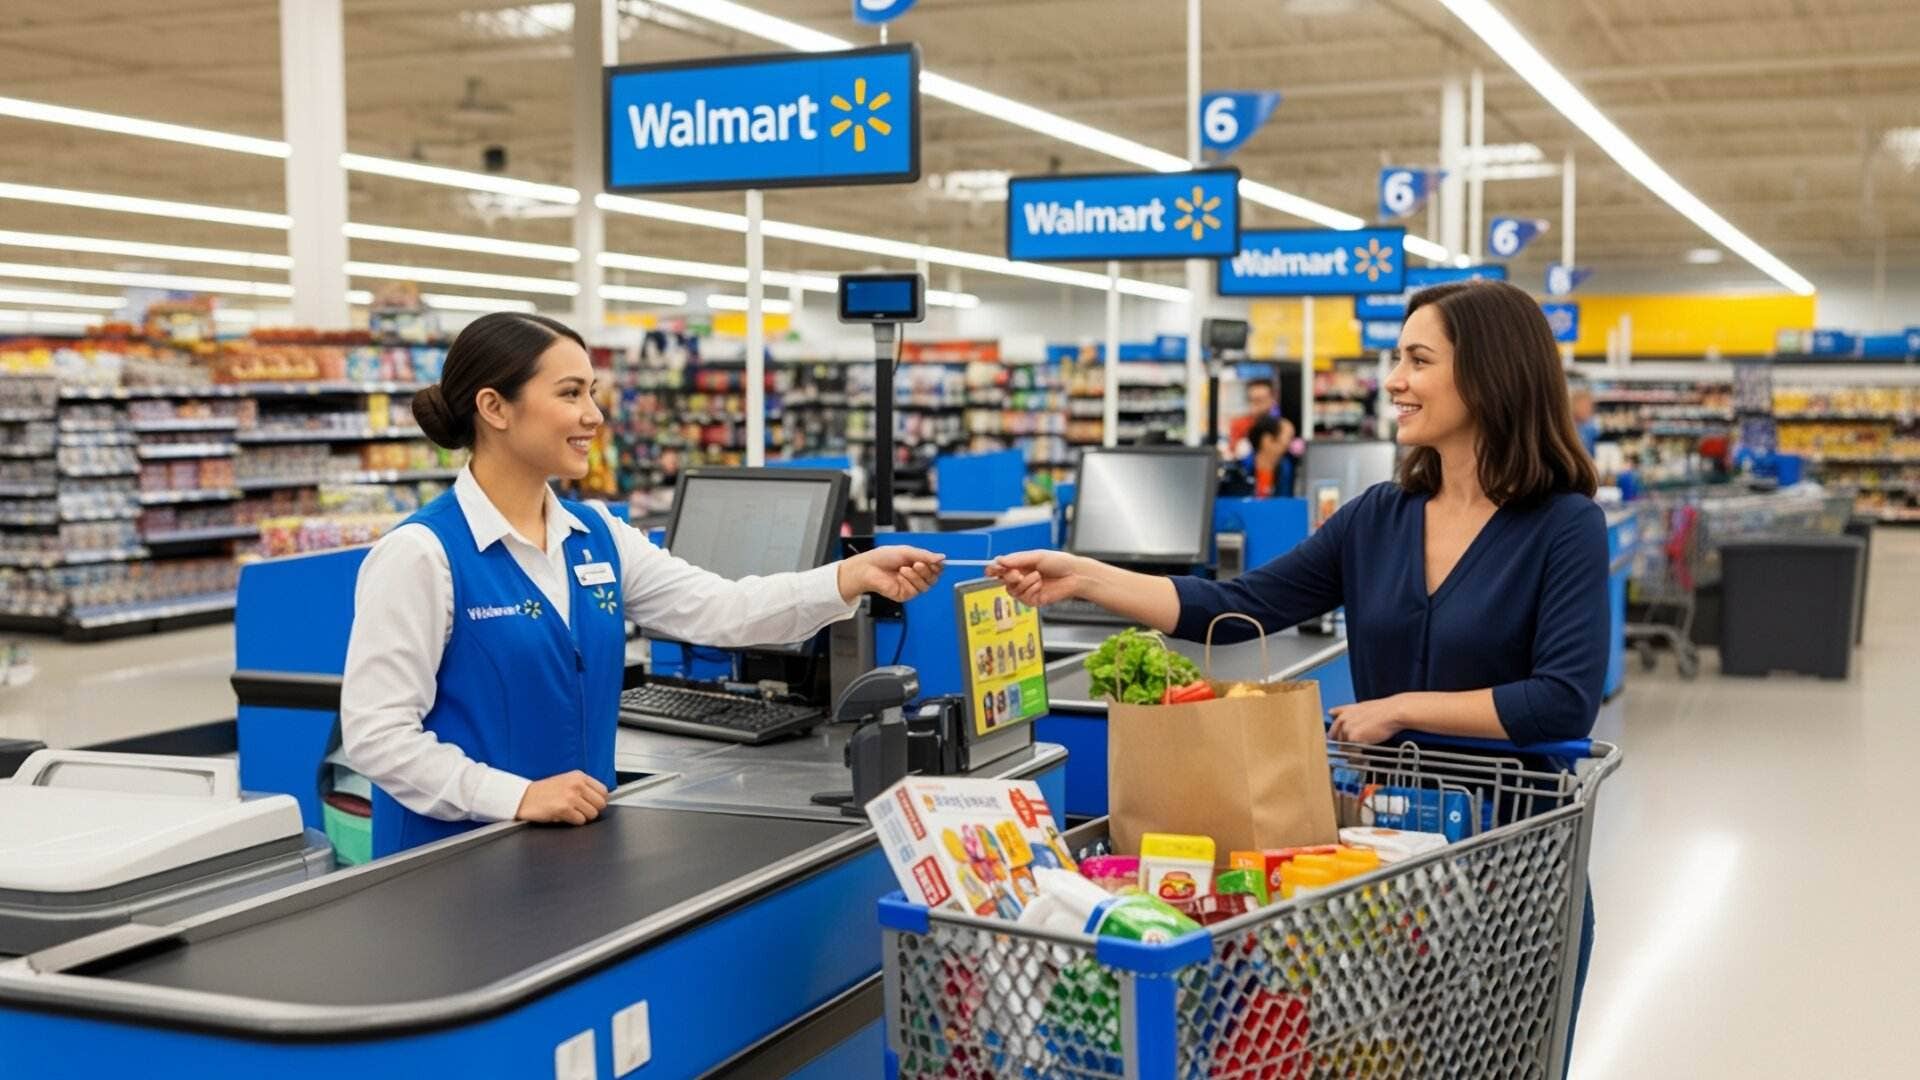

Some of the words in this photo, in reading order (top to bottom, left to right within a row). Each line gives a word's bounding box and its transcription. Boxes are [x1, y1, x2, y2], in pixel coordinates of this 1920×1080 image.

[628, 95, 819, 149] Walmart
[1204, 97, 1239, 143] 6
[1384, 171, 1415, 213] 6
[1024, 197, 1166, 235] Walmart
[1492, 219, 1519, 256] 6
[1231, 247, 1349, 278] Walmart
